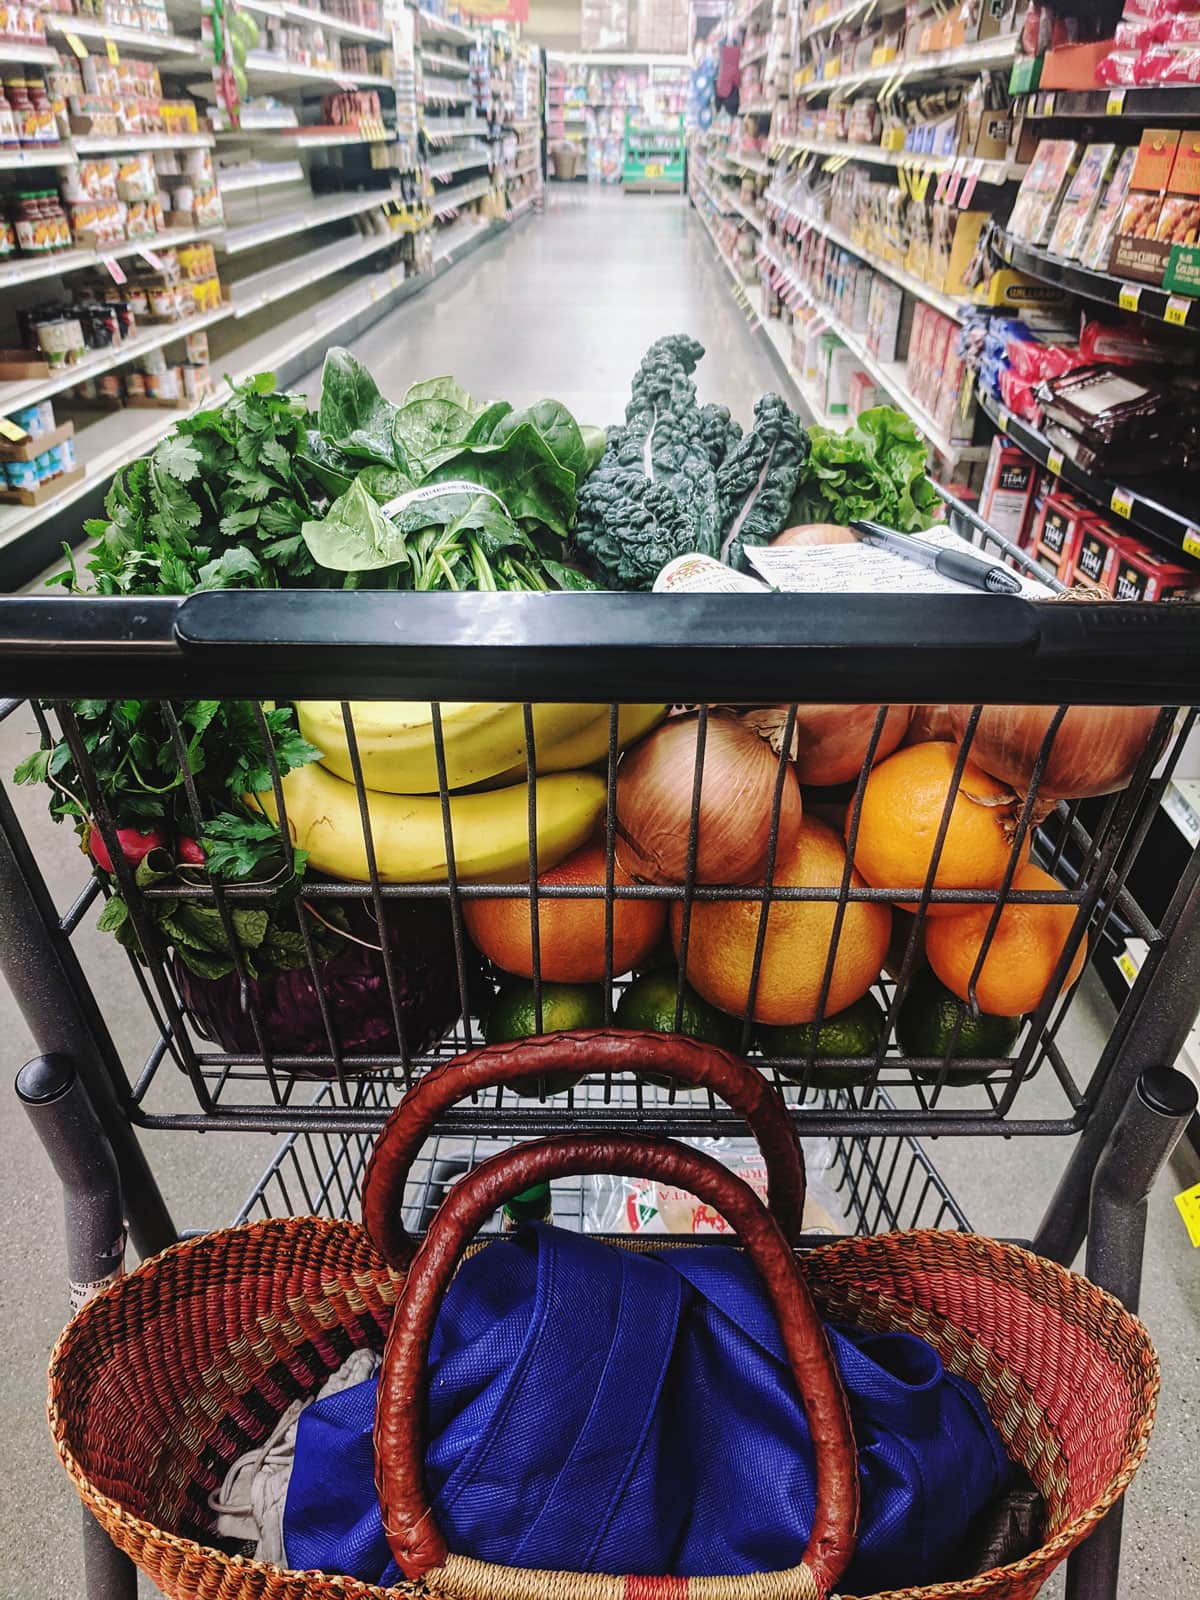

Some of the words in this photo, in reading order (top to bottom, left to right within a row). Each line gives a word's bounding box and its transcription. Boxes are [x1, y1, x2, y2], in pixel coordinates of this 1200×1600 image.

[1044, 522, 1063, 547] THAI
[1081, 547, 1102, 573] THAI
[1118, 575, 1140, 602] THAI
